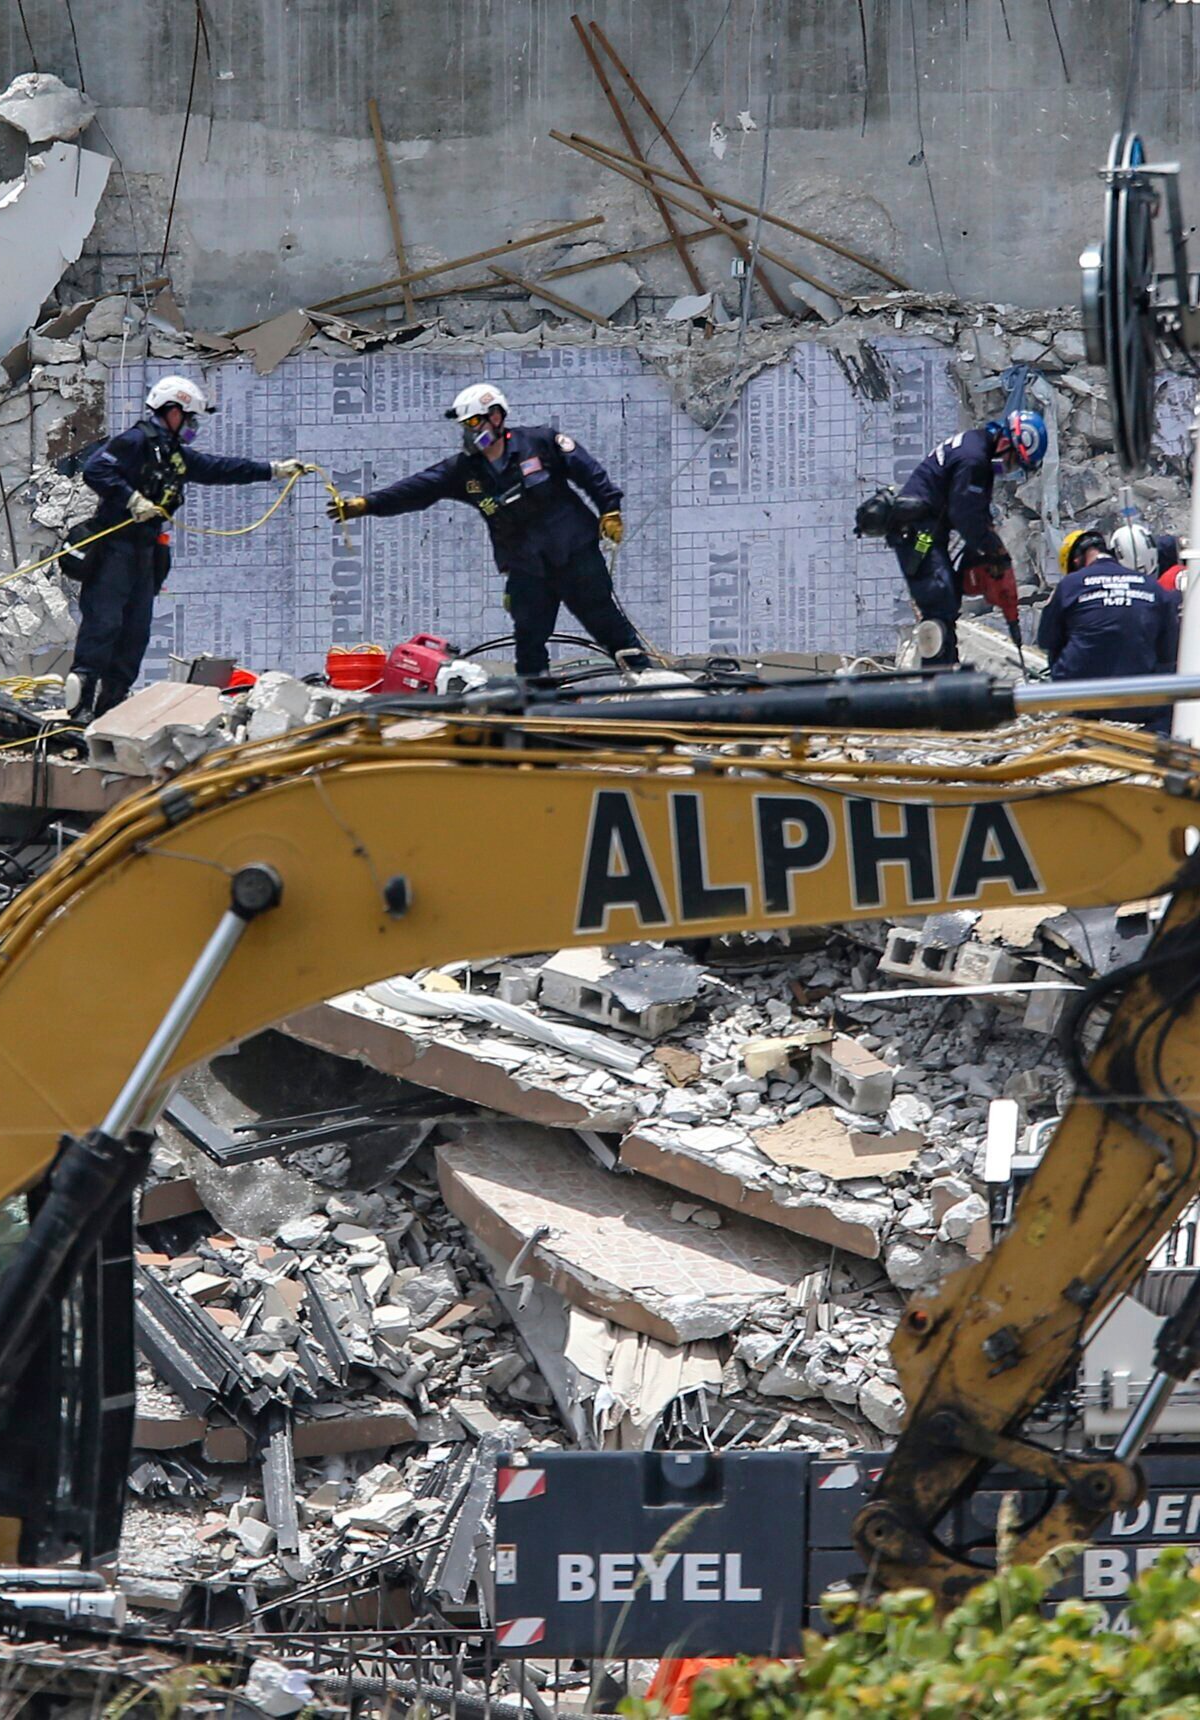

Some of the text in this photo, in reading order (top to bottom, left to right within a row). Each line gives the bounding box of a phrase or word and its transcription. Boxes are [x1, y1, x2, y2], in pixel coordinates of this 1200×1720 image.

[333, 358, 363, 415] PR
[709, 401, 739, 496] PRO
[332, 468, 362, 643] PROFLX
[574, 787, 1047, 934] ALPHA
[557, 1553, 762, 1602] BEYEL
